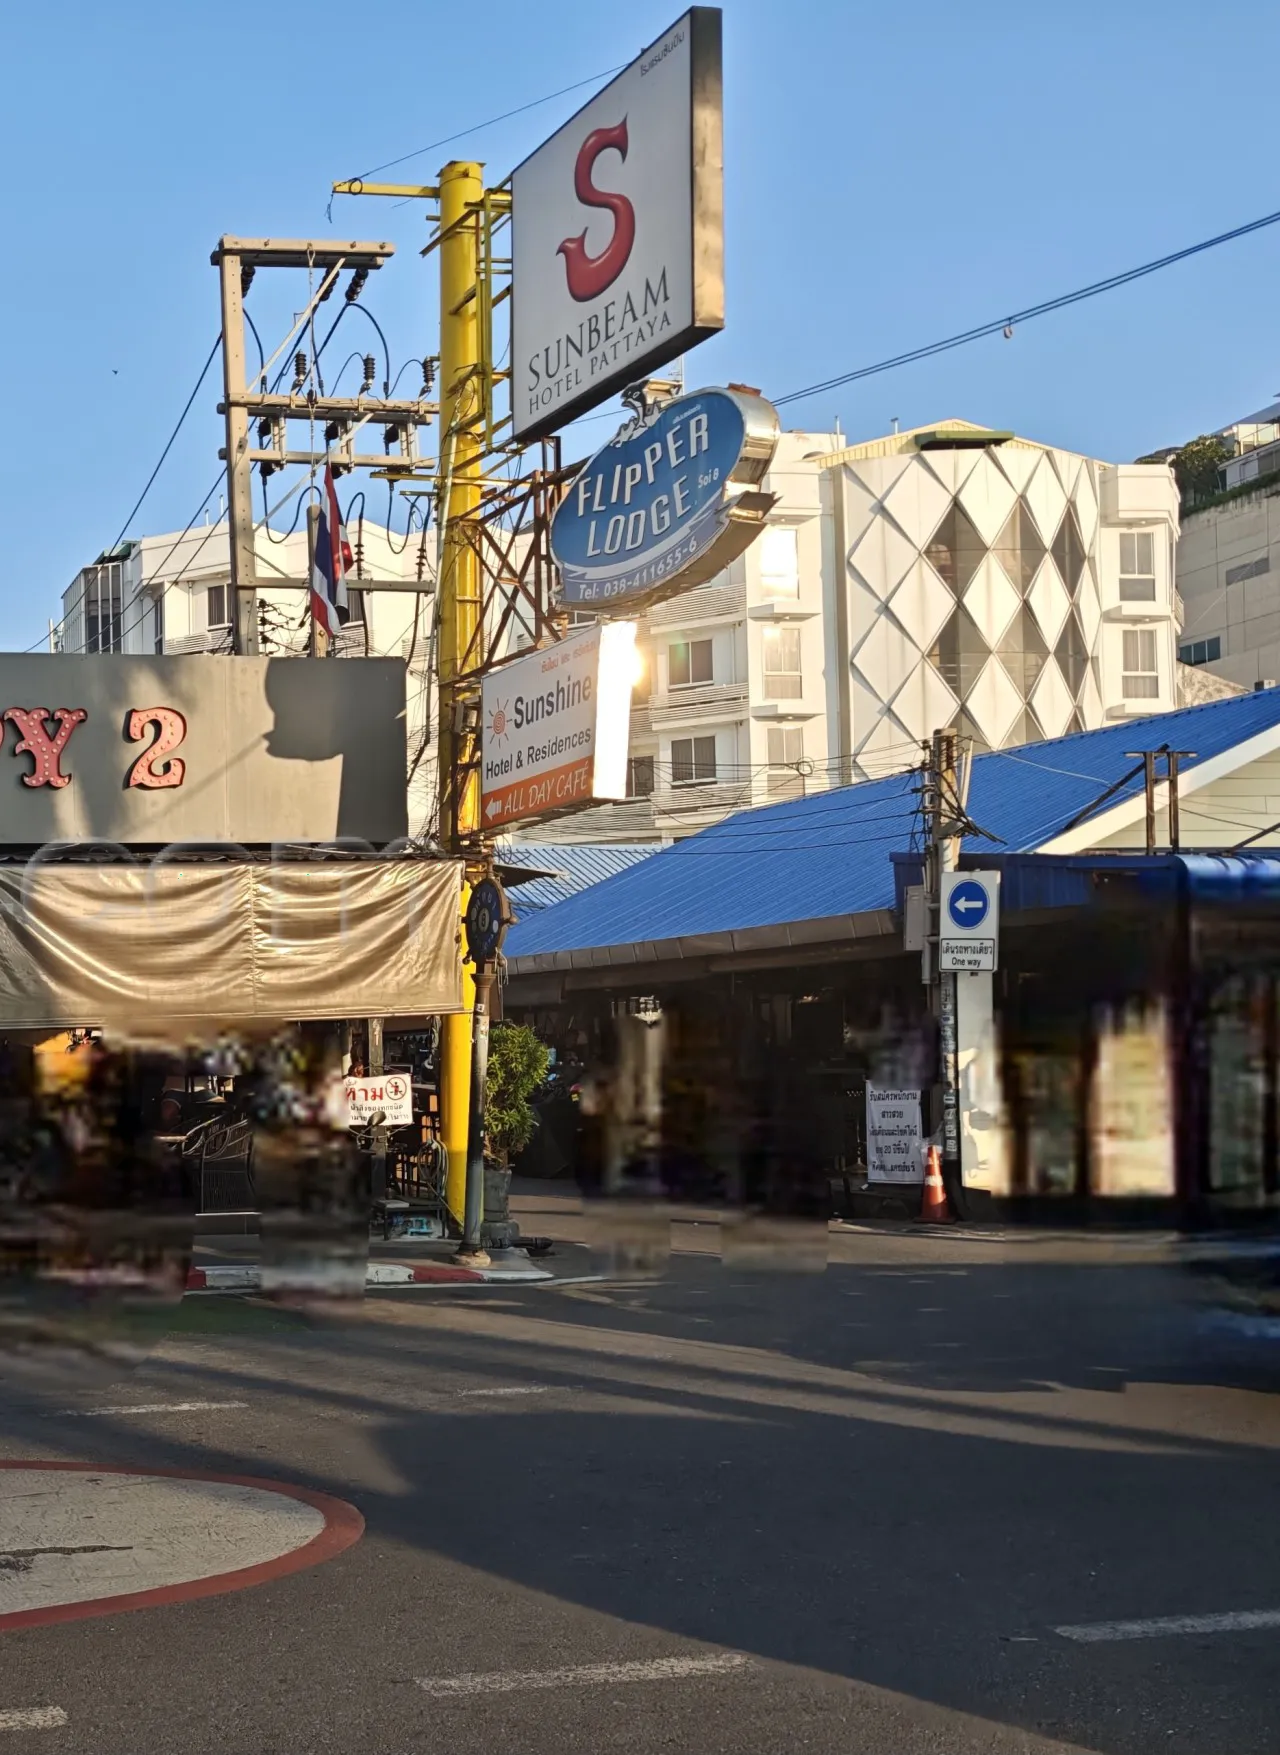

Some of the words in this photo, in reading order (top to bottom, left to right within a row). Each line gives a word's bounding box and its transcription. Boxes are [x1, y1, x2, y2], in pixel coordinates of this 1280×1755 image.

[528, 264, 670, 392] SUNBEAM
[529, 368, 582, 415] HOTEL
[590, 310, 671, 376] PATTAYA
[577, 413, 709, 517] FLIPPER
[587, 474, 692, 557] LODGE
[698, 469, 712, 489] Soi
[580, 583, 600, 600] Tel:
[604, 536, 697, 597] 038-411655-6
[514, 675, 592, 729] Sunshine
[123, 707, 187, 789] 2
[486, 753, 513, 780] Hotel
[516, 750, 523, 769] &
[527, 728, 591, 765] Residences
[504, 788, 525, 816] ALL
[529, 777, 554, 808] DAY
[556, 760, 589, 798] CAFÉ
[951, 956, 966, 966] One
[967, 959, 981, 968] way
